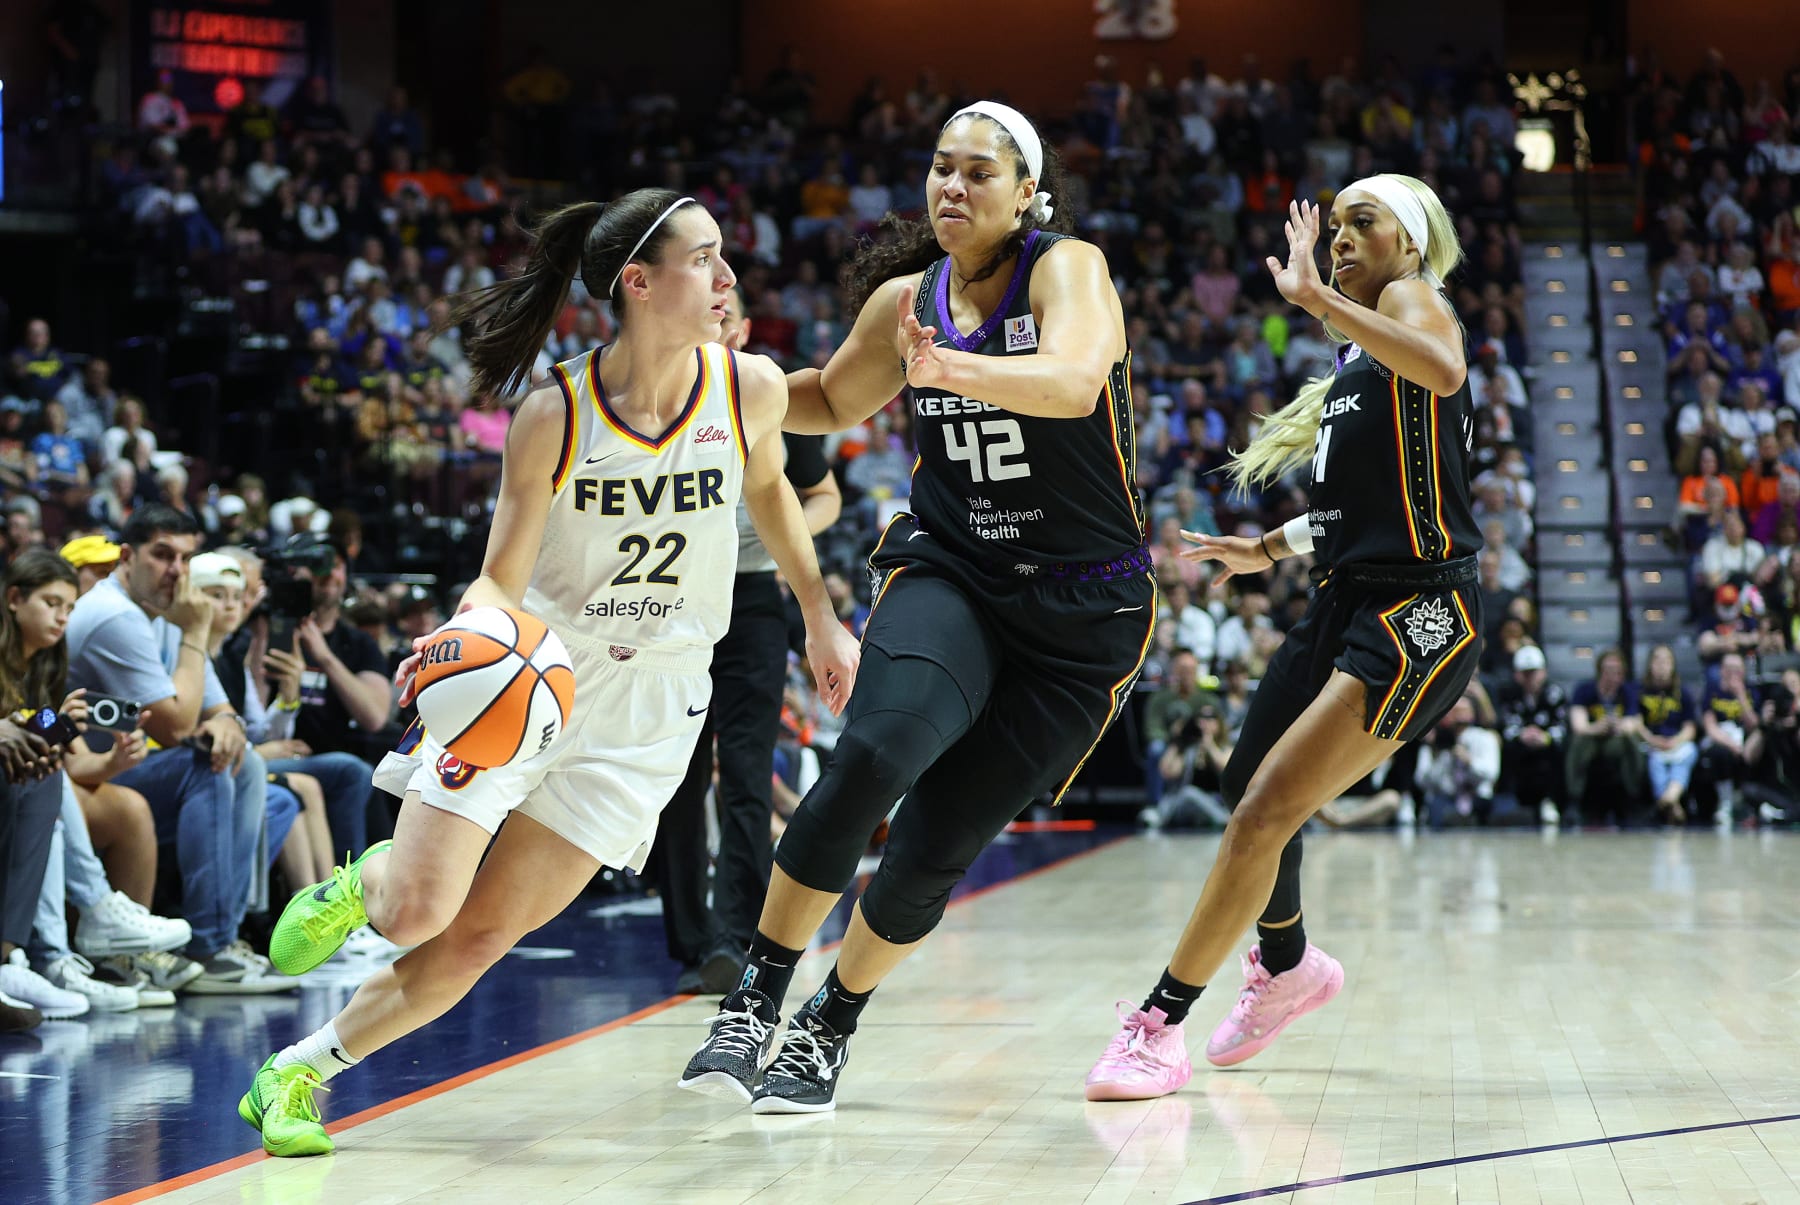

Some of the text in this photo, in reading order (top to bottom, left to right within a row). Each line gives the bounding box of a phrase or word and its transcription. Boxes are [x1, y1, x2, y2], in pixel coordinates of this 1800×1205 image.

[1009, 331, 1034, 344] Post
[1320, 393, 1361, 424] USK
[694, 425, 729, 445] Lilly
[942, 419, 1031, 482] 42
[574, 468, 725, 517] FEVER
[966, 496, 992, 510] Yale
[969, 508, 1044, 525] NewHaven
[610, 532, 687, 587] 22
[584, 596, 684, 621] salesfore
